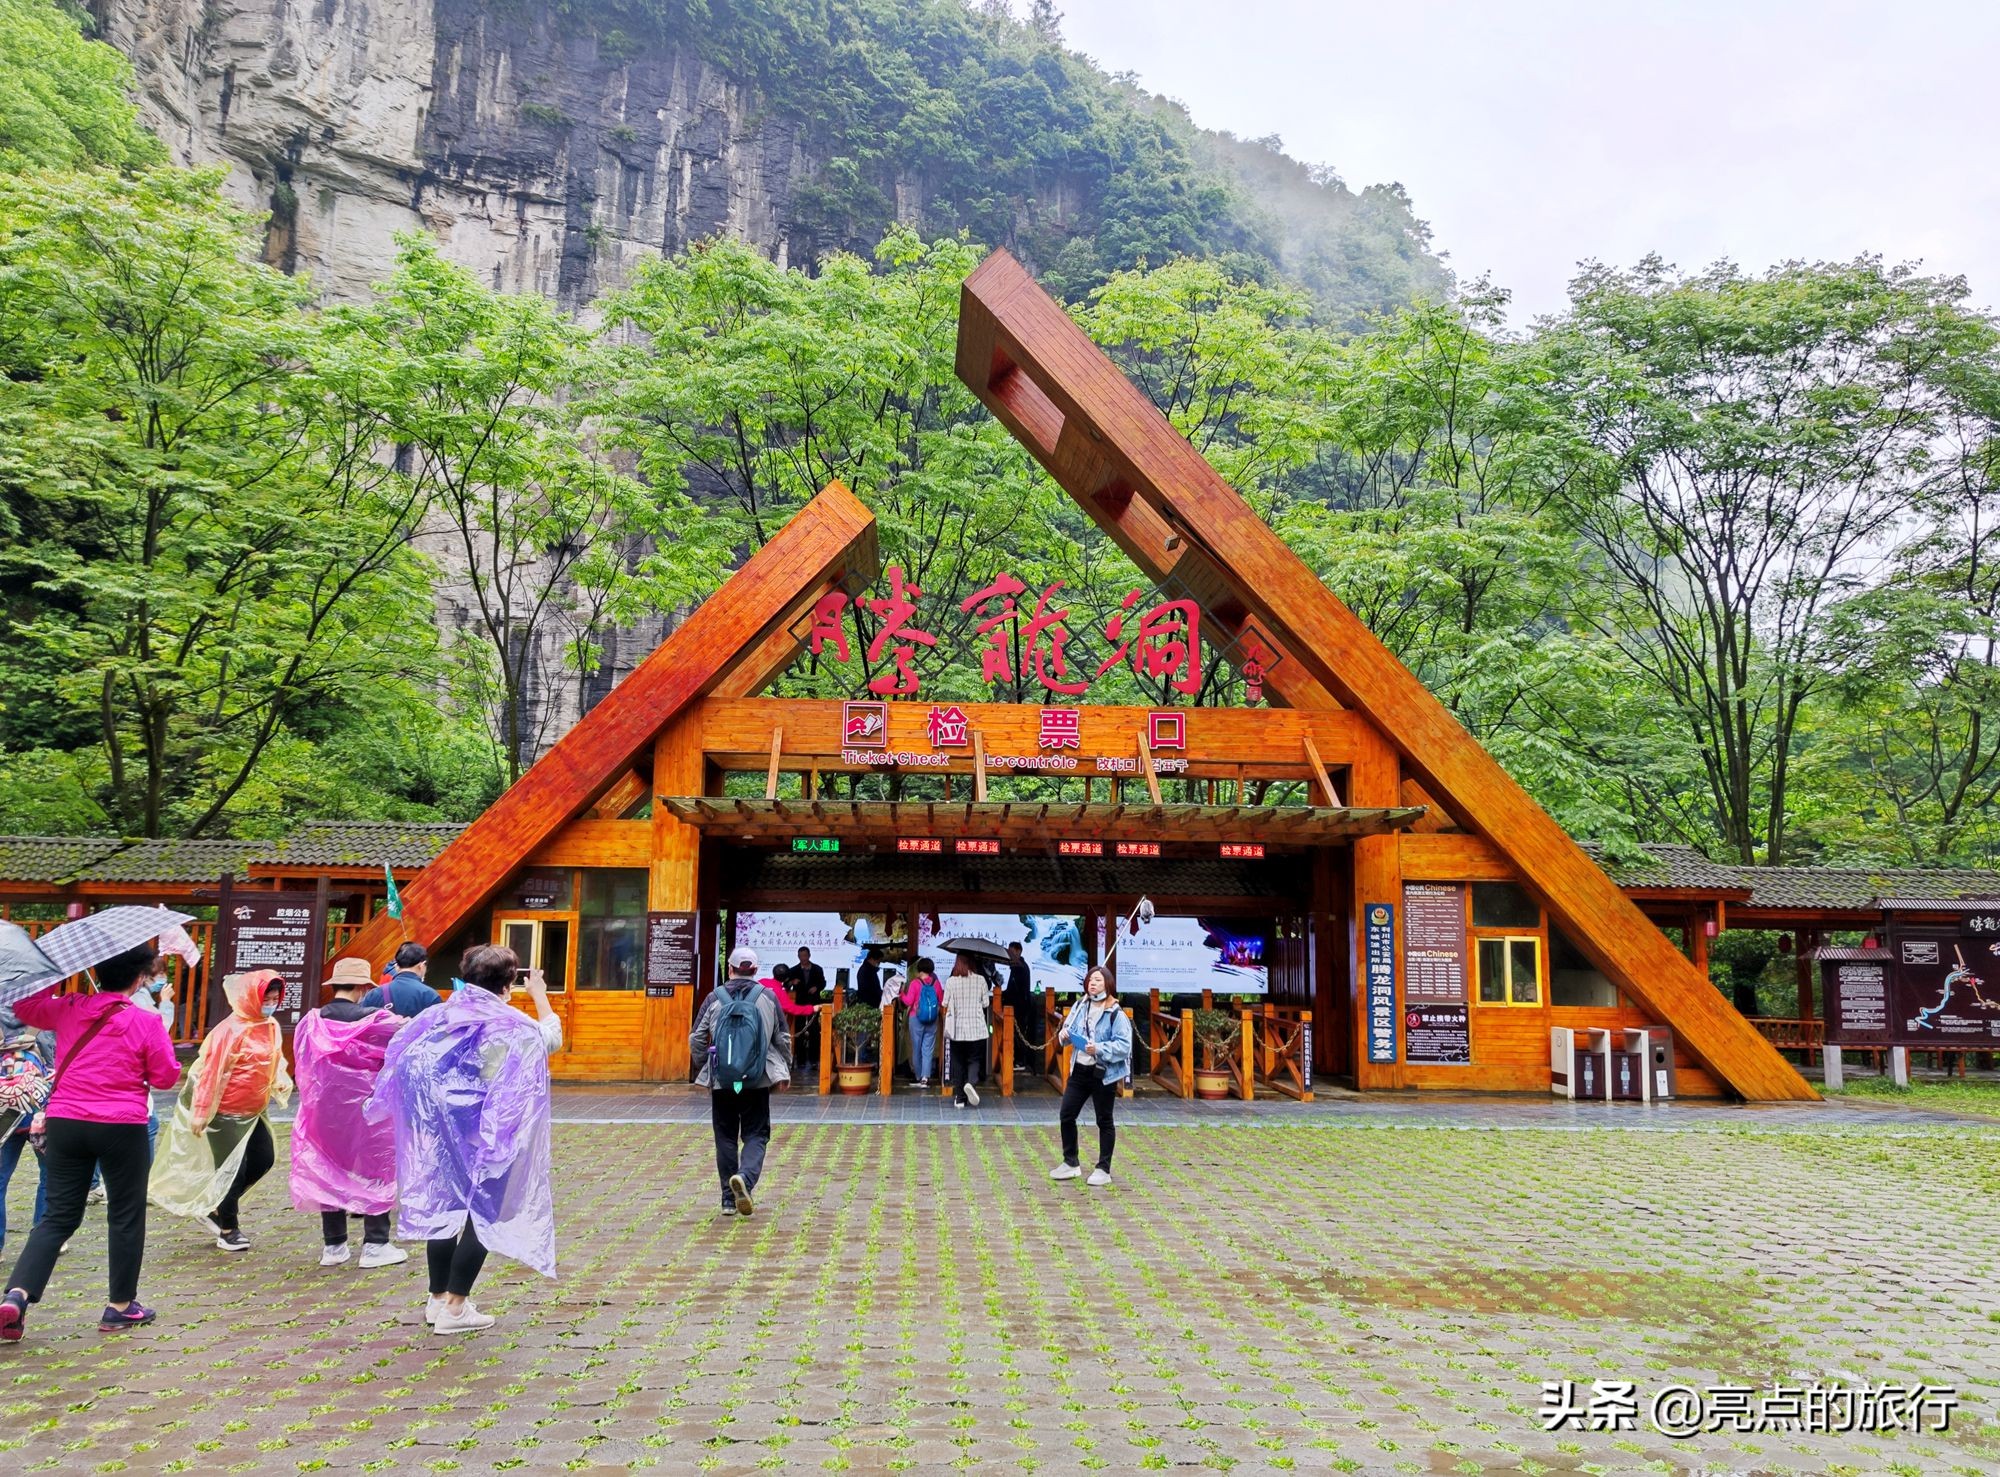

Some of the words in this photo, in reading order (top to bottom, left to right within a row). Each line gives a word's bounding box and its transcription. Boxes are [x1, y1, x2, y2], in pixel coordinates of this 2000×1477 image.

[927, 705, 1187, 749] 检票口
[842, 750, 893, 765] Ticket
[897, 752, 949, 766] Check
[984, 754, 1003, 768] Le
[1006, 755, 1078, 770] contrôle
[1096, 757, 1136, 772] 改札口
[898, 839, 941, 851] 检票通道
[957, 841, 999, 852] 检票通道
[1060, 841, 1102, 854] 检票通道
[1117, 843, 1159, 855] 检票通道
[1221, 845, 1264, 857] 检票通道
[1424, 884, 1457, 892] Chinese
[1426, 949, 1459, 958] Chinese
[1371, 964, 1393, 1060] 腾龙洞风景区警务室
